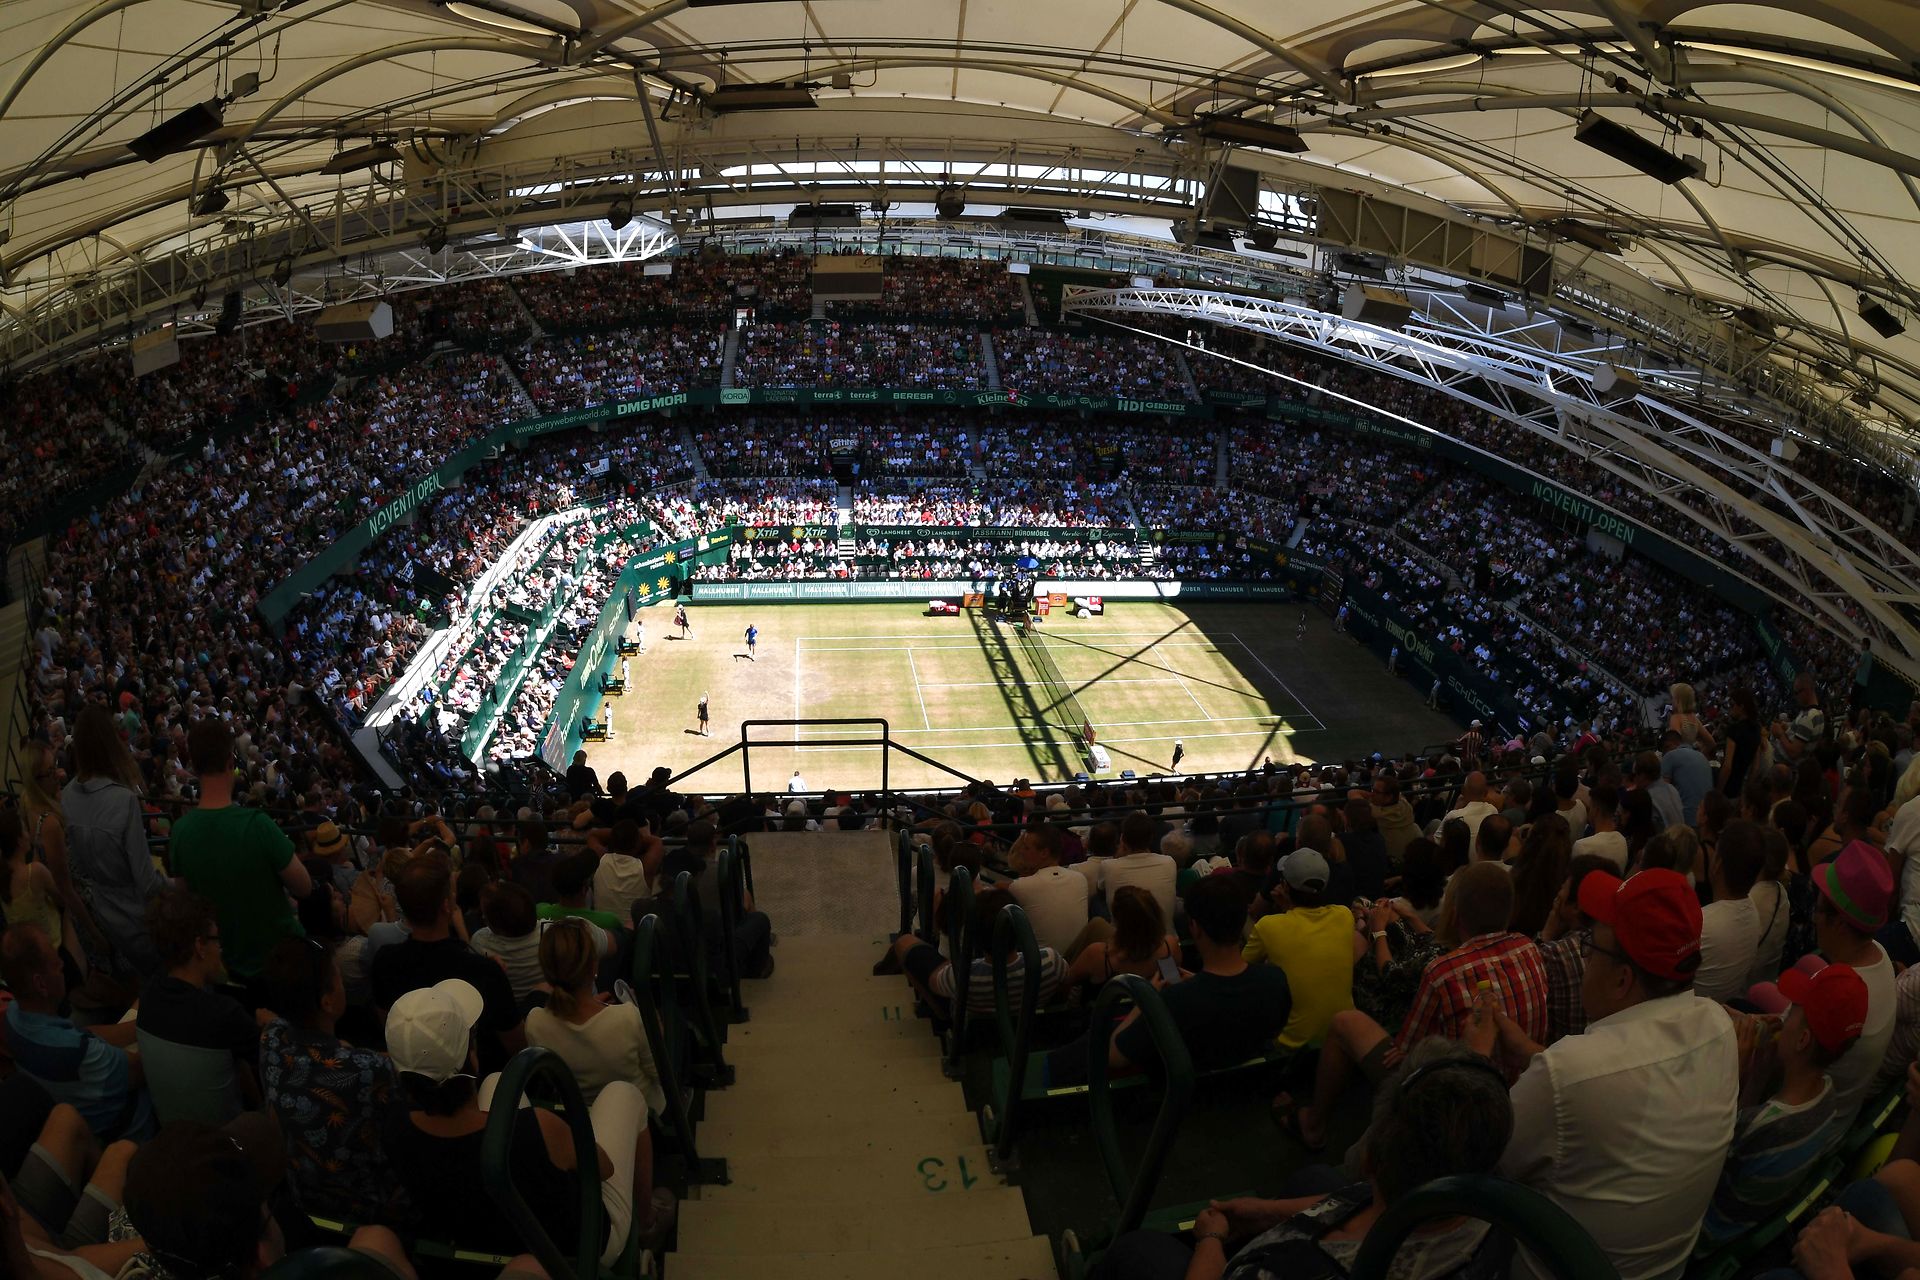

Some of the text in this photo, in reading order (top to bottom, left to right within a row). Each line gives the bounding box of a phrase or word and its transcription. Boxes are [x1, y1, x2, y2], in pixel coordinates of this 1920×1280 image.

[617, 393, 688, 415] DMG MORI
[723, 392, 749, 400] KORDA
[893, 392, 934, 400] BERESA
[1117, 400, 1144, 412] HDI
[514, 408, 610, 434] www.gerryweber-world.de
[369, 473, 440, 538] NOVENTI OPEN
[1533, 481, 1635, 544] NOVENTI OPEN
[1015, 529, 1049, 537] BÜROMÖBEL
[1447, 675, 1491, 717] SCHÜCO
[917, 1156, 977, 1192] 13
